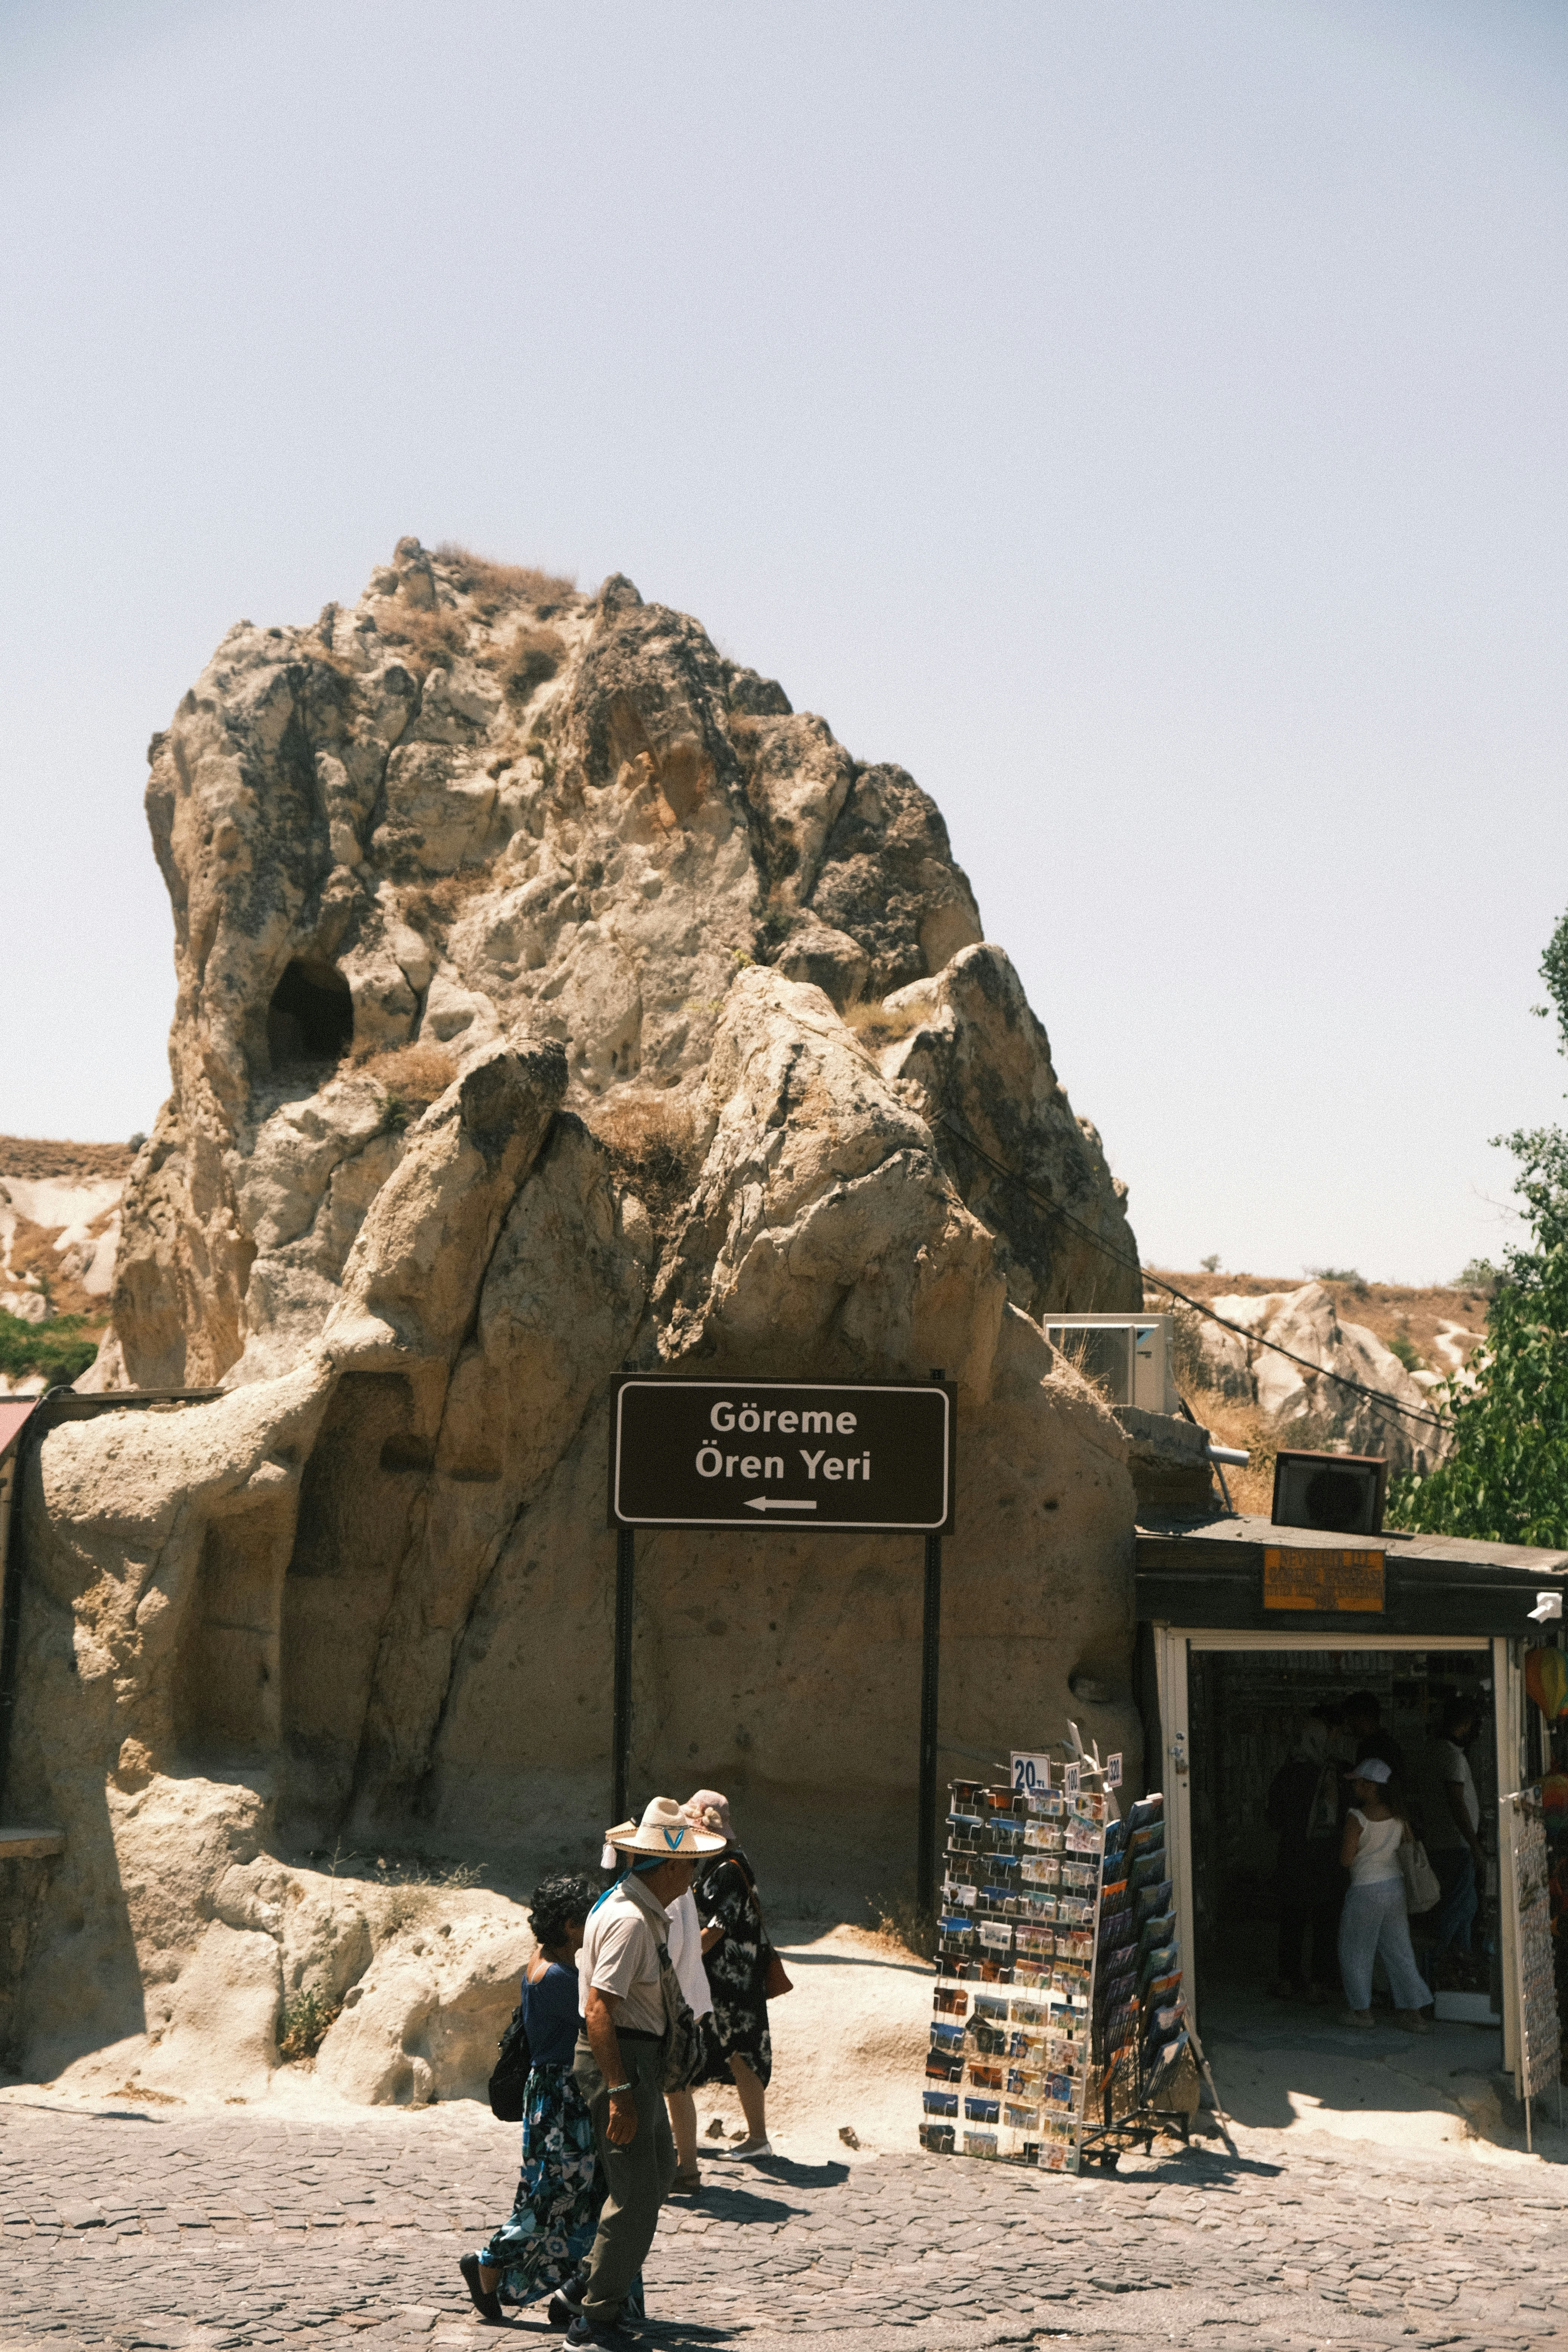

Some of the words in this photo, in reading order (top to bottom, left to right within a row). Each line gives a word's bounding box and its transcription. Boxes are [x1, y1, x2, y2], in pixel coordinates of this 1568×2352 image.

[710, 1401, 857, 1434] Göreme
[695, 1440, 784, 1479] Ören
[799, 1450, 870, 1481] Yeri
[1015, 1759, 1036, 1789] 20
[1067, 1768, 1077, 1790] 100
[1110, 1759, 1119, 1781] 320
